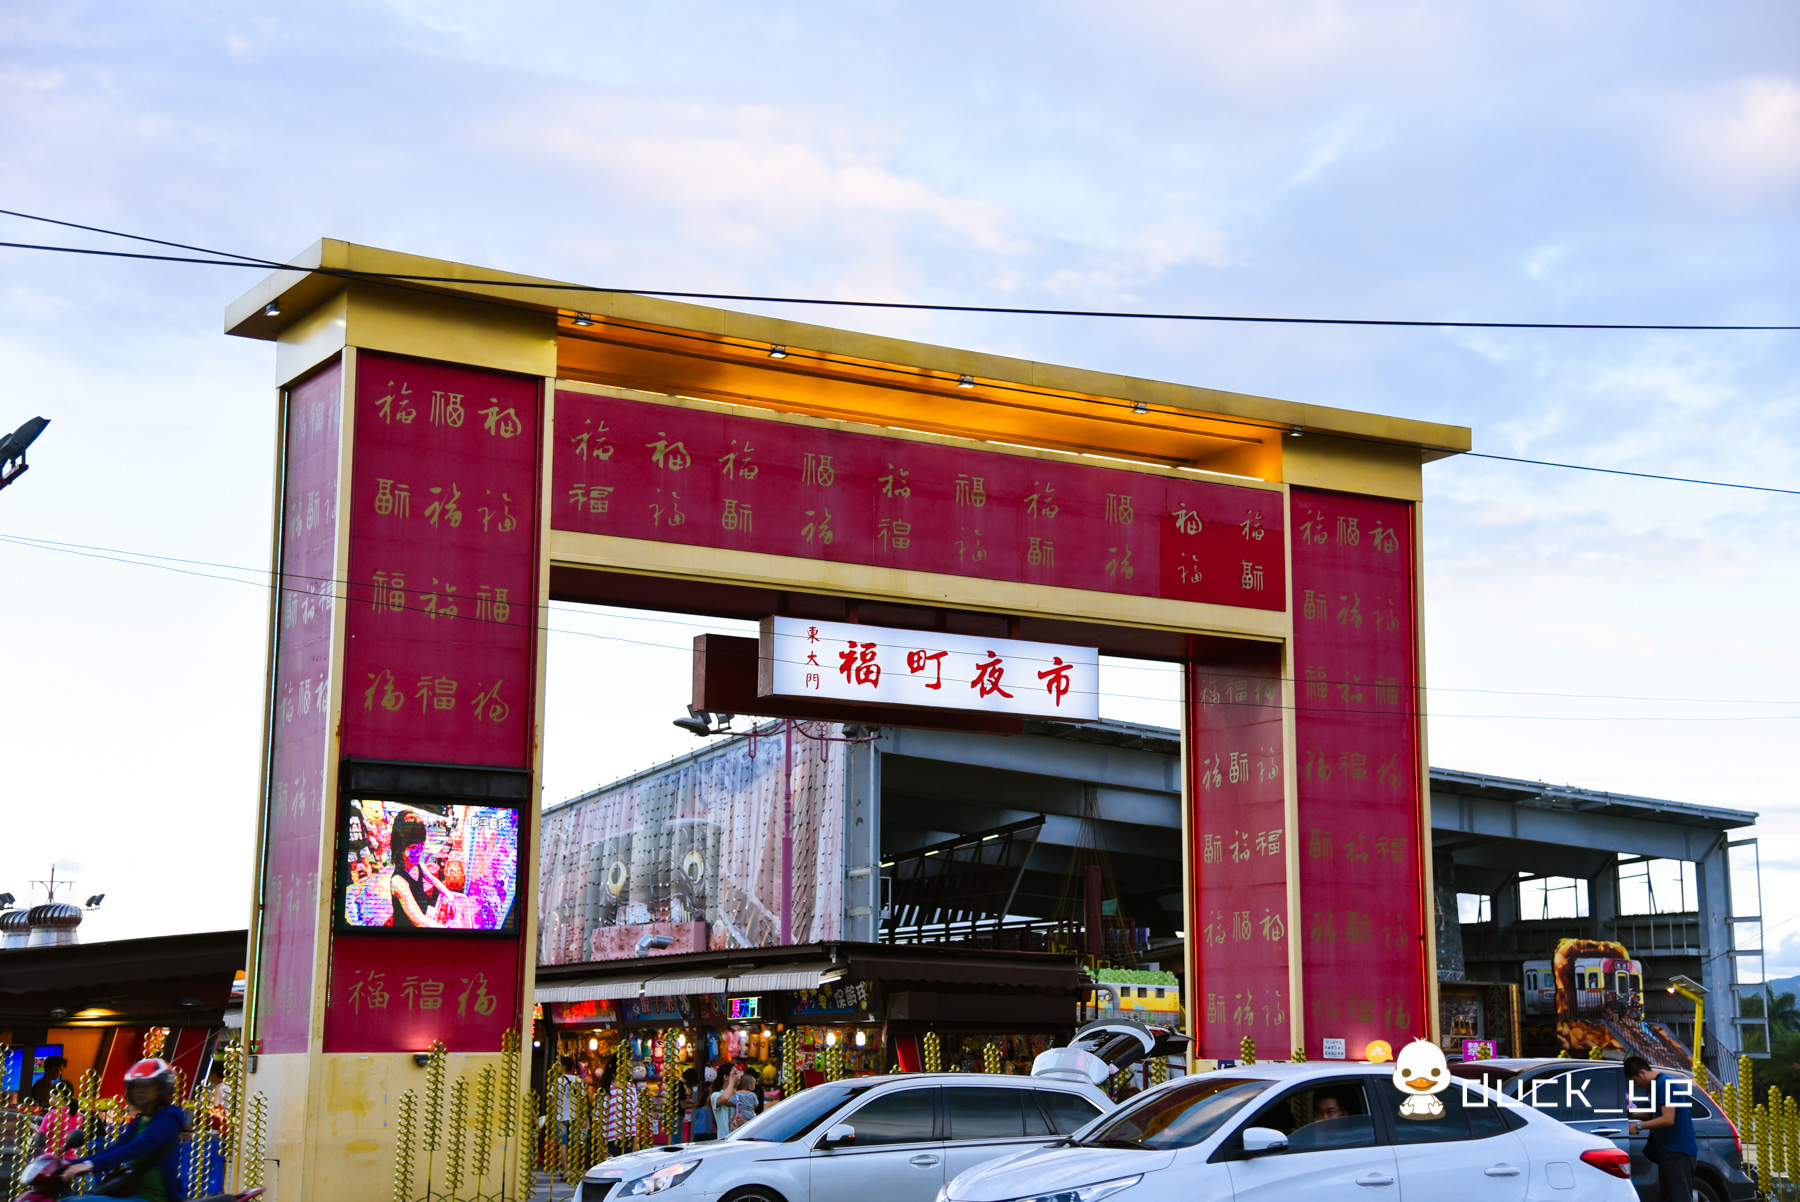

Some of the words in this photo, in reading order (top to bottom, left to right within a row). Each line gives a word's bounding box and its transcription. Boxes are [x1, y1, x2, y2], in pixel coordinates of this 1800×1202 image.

[805, 625, 821, 690] 東大門
[839, 640, 1074, 707] 福町夜市
[732, 998, 758, 1018] 東大門
